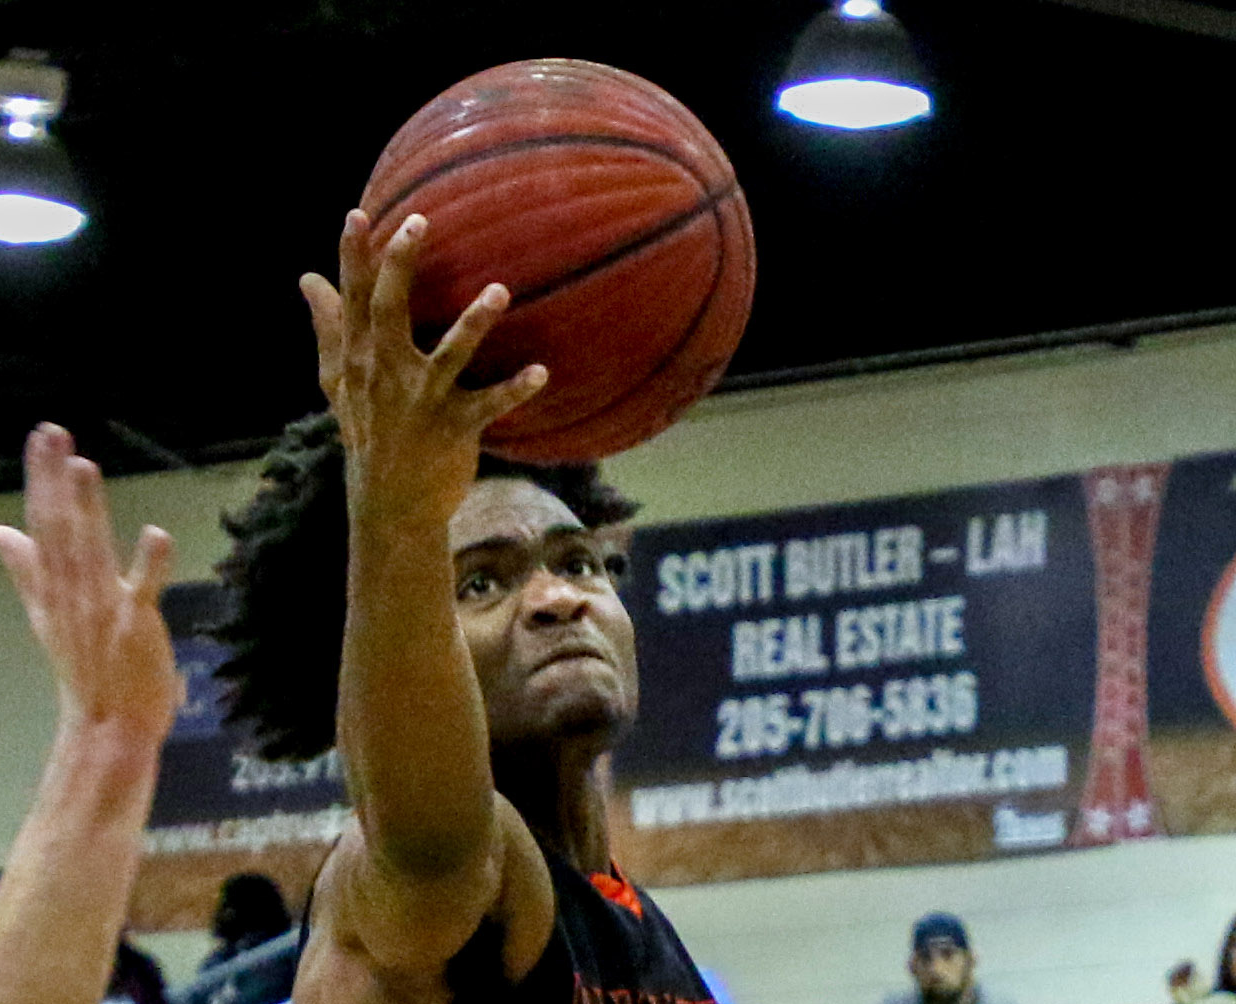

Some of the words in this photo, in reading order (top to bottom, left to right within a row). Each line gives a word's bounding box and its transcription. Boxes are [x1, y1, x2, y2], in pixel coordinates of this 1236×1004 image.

[657, 544, 776, 614] SCOTT
[784, 525, 925, 598] BUTLER
[966, 510, 1048, 577] LAH
[731, 613, 831, 682] REAL
[835, 596, 967, 667] ESTATE
